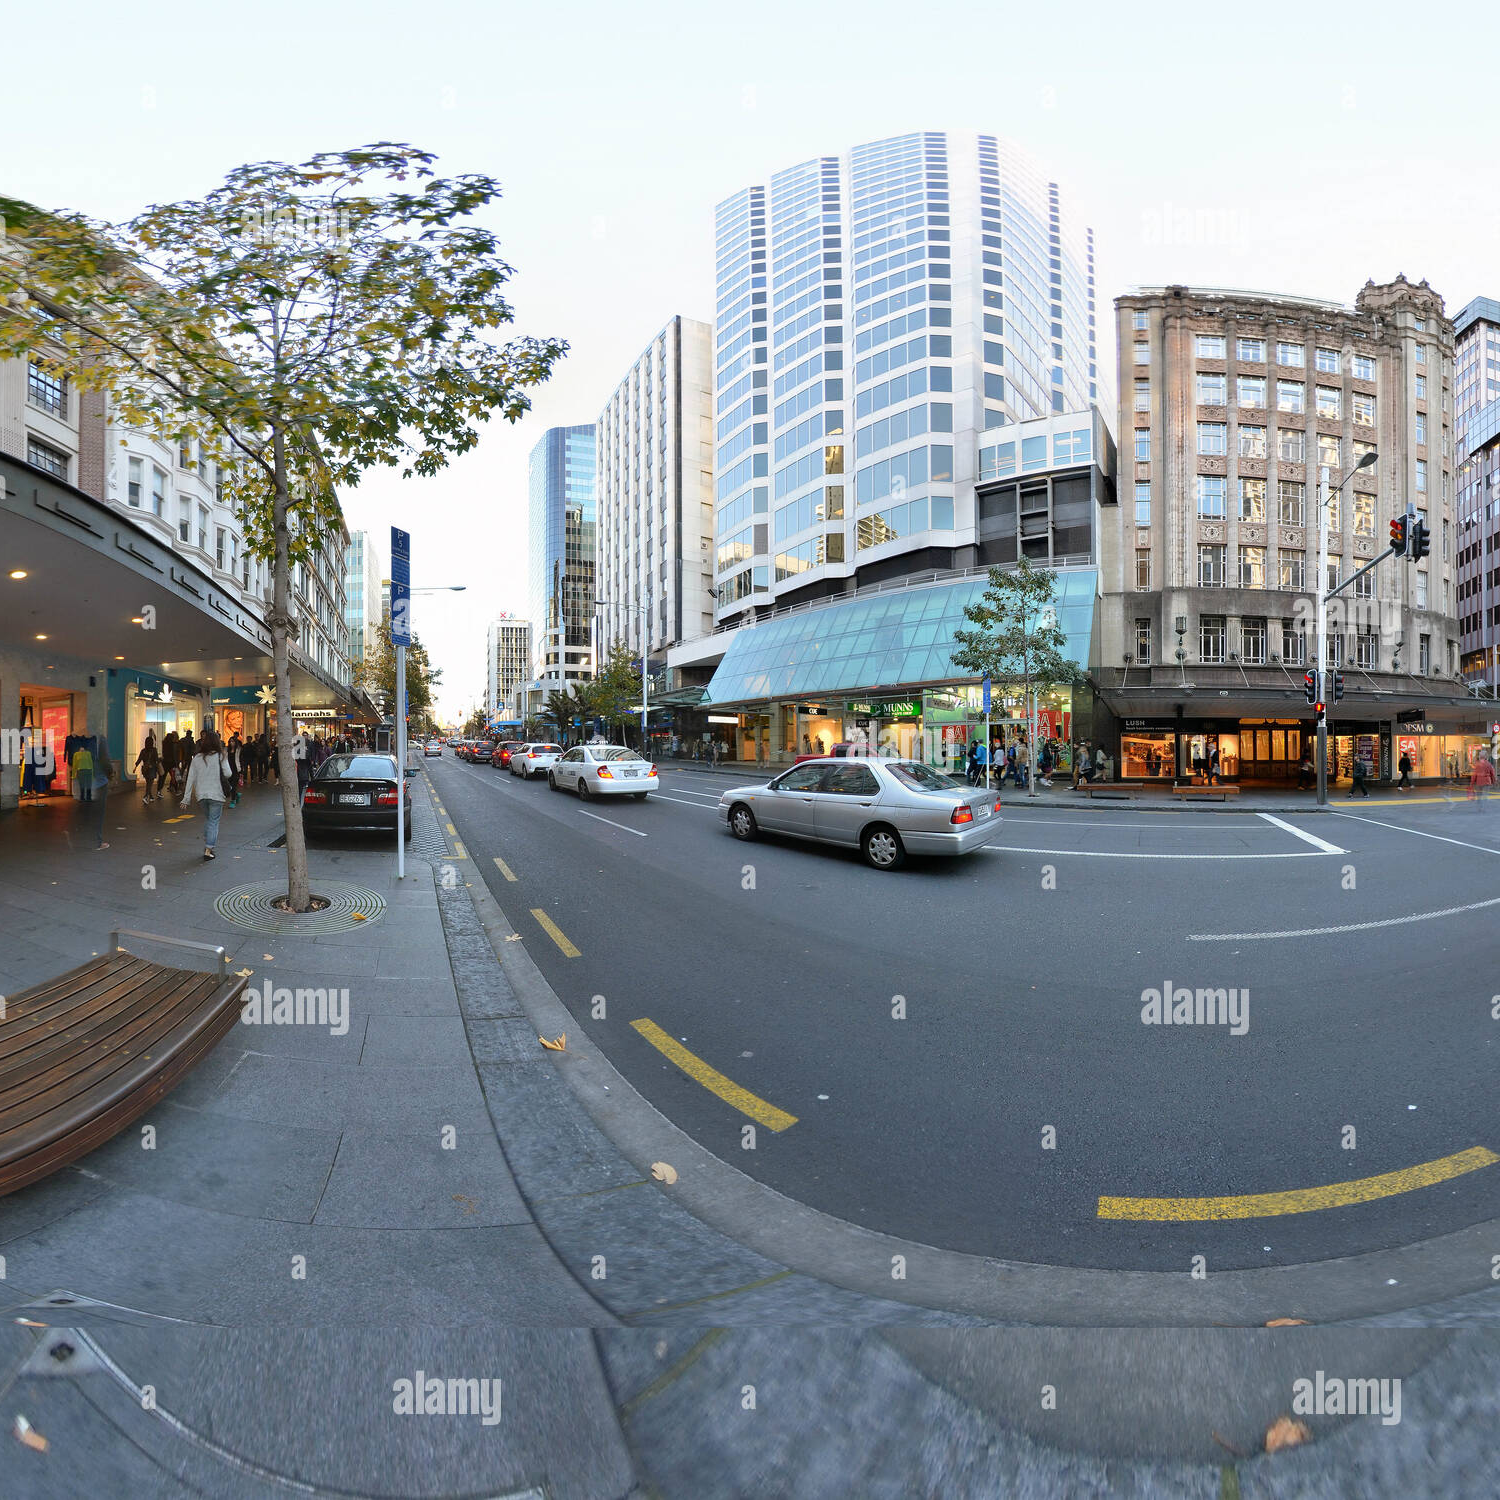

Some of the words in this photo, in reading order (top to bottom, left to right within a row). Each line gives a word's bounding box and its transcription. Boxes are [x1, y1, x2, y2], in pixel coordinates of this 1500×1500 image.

[397, 586, 404, 595] P
[883, 702, 913, 712] MUNNS
[1400, 740, 1416, 751] SA
